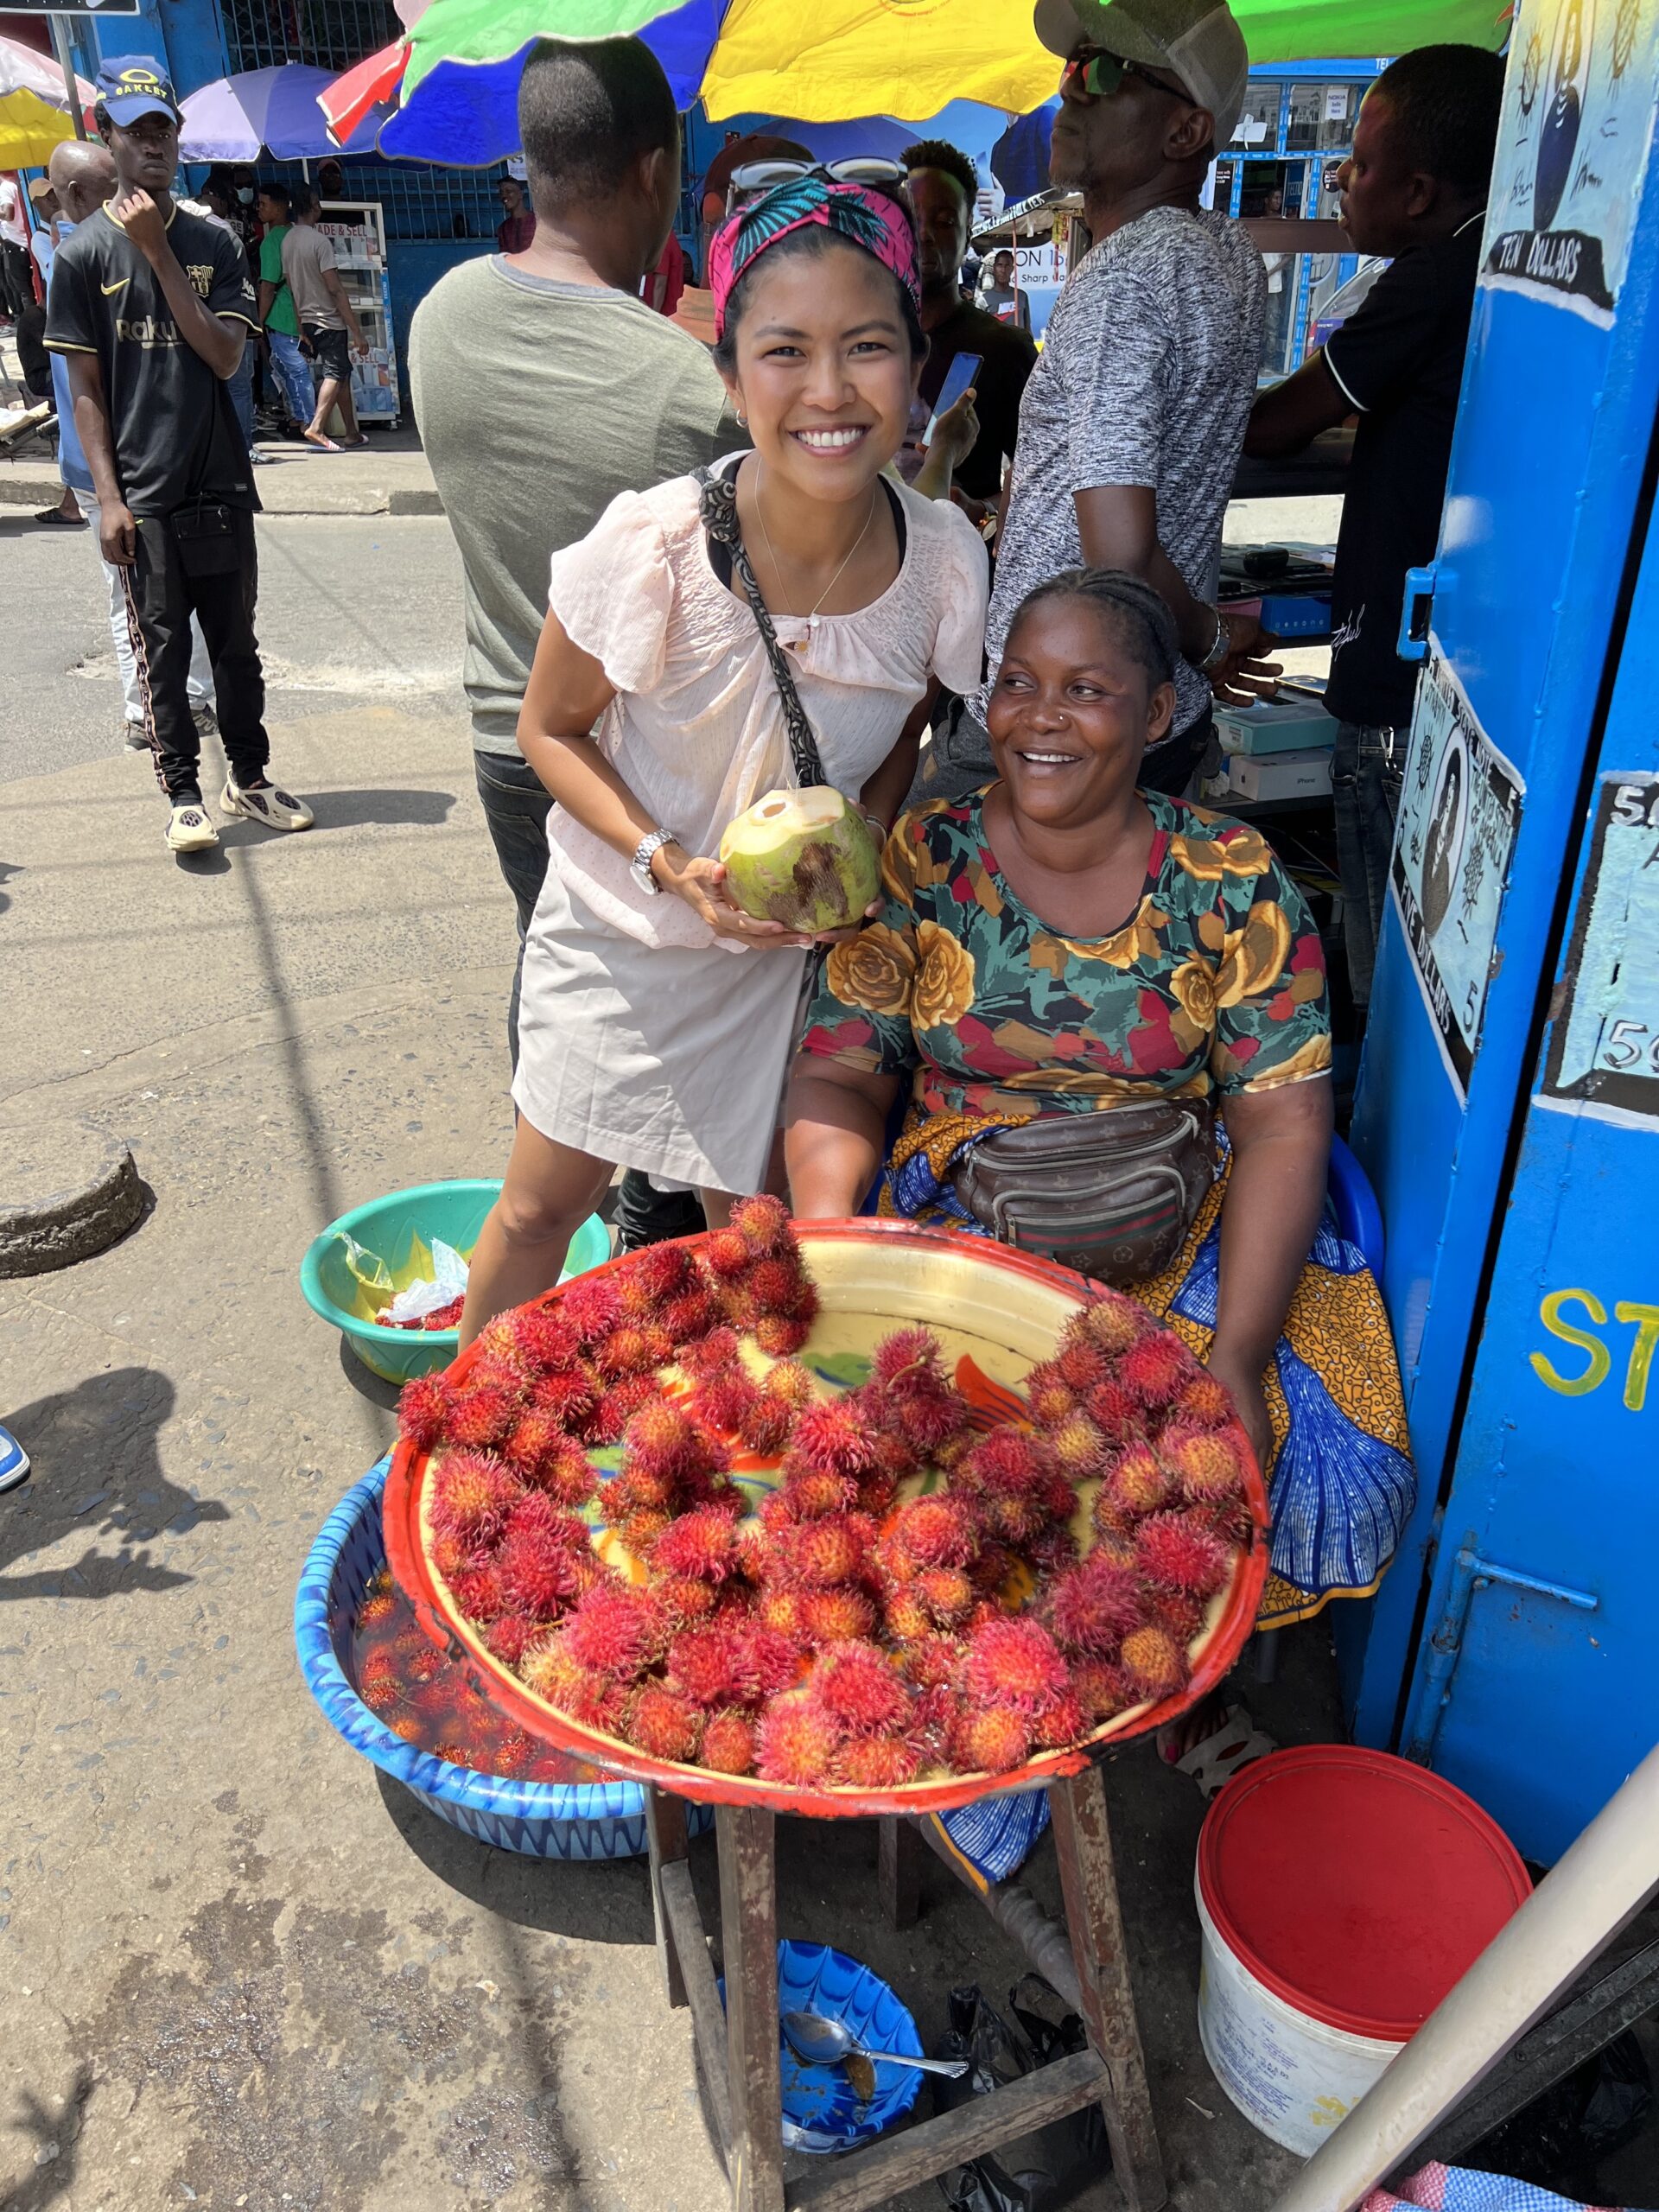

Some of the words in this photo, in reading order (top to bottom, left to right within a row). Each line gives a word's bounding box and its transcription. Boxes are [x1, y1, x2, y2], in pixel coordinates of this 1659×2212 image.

[116, 84, 167, 99] OAKLEY
[312, 224, 335, 235] ADE
[346, 225, 367, 236] SELL
[1015, 250, 1041, 266] ON
[1499, 232, 1525, 270] TEN
[1526, 232, 1582, 283] DOLLARS
[1021, 274, 1048, 283] Sharp
[116, 315, 178, 342] Raku
[1506, 785, 1517, 827] 5
[1610, 785, 1659, 826] 5
[1417, 925, 1451, 1034] DOLLARS
[1463, 979, 1478, 1033] 5
[1529, 1287, 1659, 1412] ST
